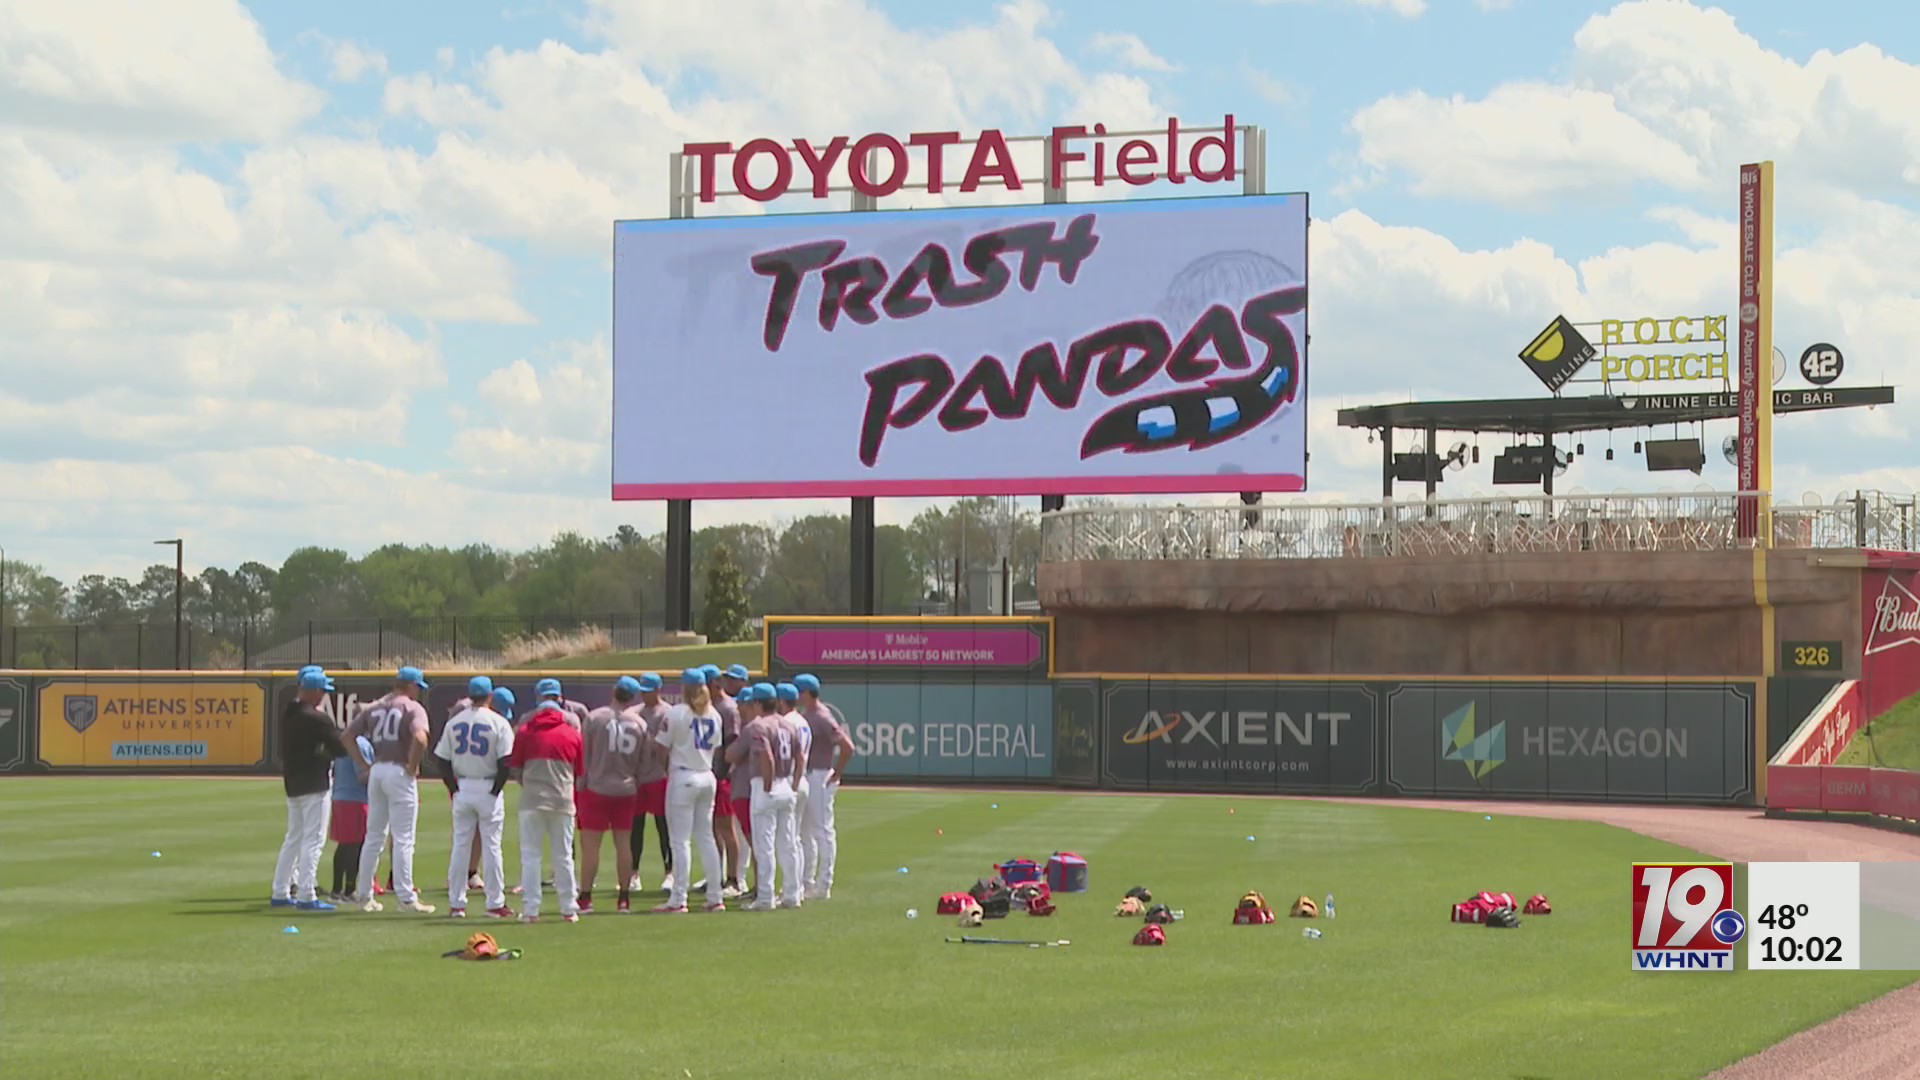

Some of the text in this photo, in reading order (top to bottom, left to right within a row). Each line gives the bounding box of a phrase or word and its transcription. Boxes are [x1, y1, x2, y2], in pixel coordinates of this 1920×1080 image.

[683, 113, 1235, 203] TOYOTA Field
[1744, 188, 1754, 297] WHOLESALE CLUB
[1602, 315, 1727, 346] ROCK
[1547, 345, 1593, 390] INLINE
[1602, 352, 1729, 383] PORCH
[1742, 328, 1755, 386] Absurdly
[1803, 350, 1838, 378] 42
[859, 286, 1306, 467] PANDAS
[1645, 392, 1834, 409] INLINE ELEIC BAR
[1742, 389, 1755, 434] Simple
[821, 649, 994, 661] AMERICA'S LARGEST 5G NETWORK
[1794, 646, 1830, 666] 326
[103, 697, 249, 716] ATHENS STATE
[122, 719, 234, 731] UNIVERSITY
[369, 708, 402, 742] 20
[452, 722, 492, 757] 35
[605, 718, 637, 754] 16
[688, 717, 716, 750] 12
[923, 723, 1046, 758] FEDERAL
[1123, 709, 1351, 748] AXIENT
[1522, 725, 1688, 759] HEXAGON
[116, 743, 205, 757] ATHENS.EDU
[1166, 758, 1310, 773] www.axientcorp.com
